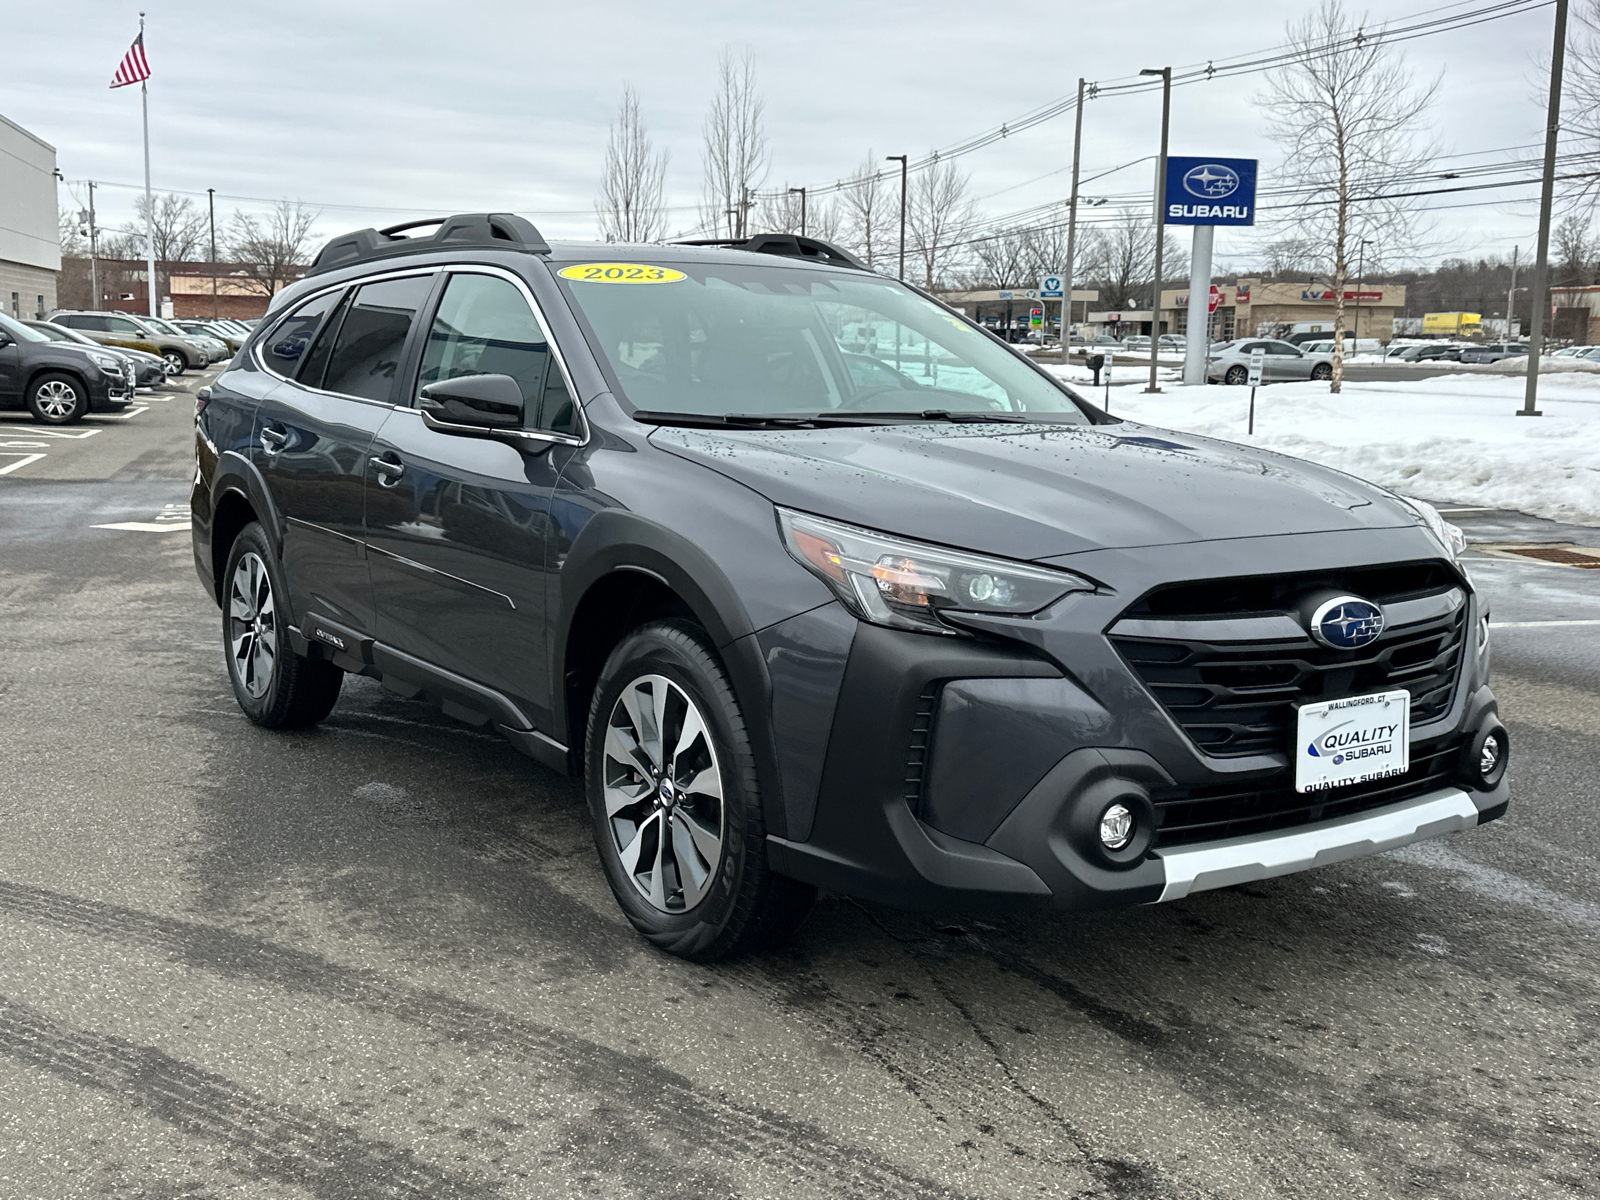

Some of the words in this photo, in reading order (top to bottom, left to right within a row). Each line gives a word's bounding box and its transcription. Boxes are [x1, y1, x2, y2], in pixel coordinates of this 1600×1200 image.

[1168, 204, 1248, 219] SUBARU
[584, 267, 665, 280] 2023
[1377, 694, 1387, 703] CT
[1324, 724, 1398, 748] QUALITY
[1345, 744, 1391, 761] SUBARU
[1304, 776, 1357, 793] QUALITY
[1360, 766, 1406, 783] SUBARU
